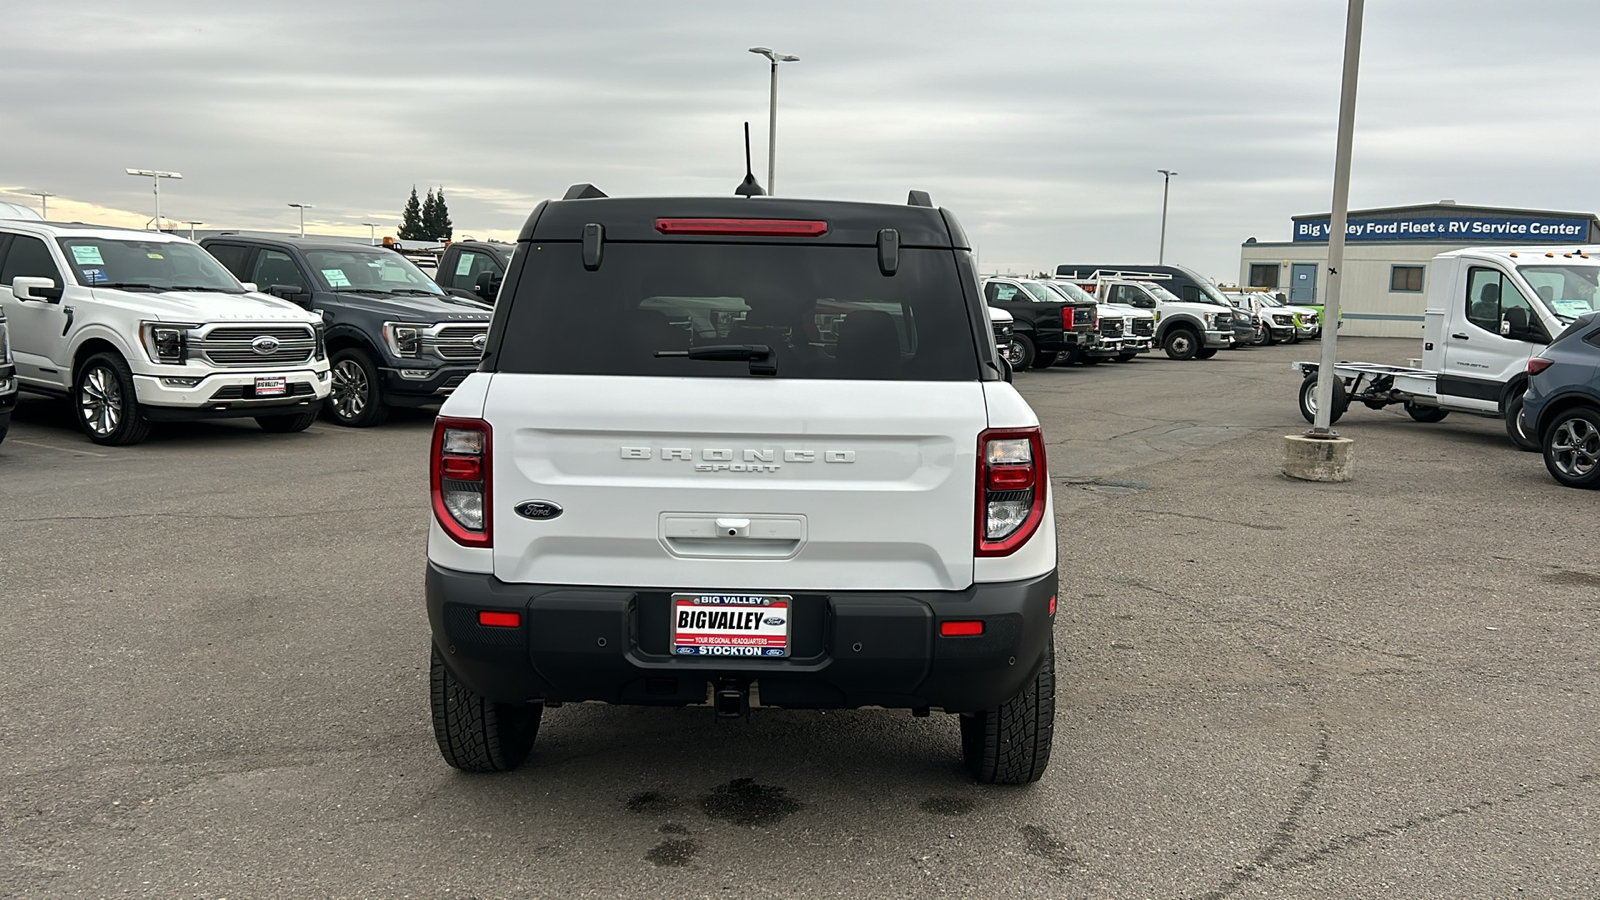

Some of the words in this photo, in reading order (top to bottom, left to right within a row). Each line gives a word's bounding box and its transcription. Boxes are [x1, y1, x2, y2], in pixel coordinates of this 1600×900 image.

[1299, 223, 1320, 236] Big
[1323, 222, 1364, 236] Vley
[1366, 222, 1397, 234] Ford
[1400, 221, 1435, 233] Fleet
[1438, 224, 1445, 233] &
[1449, 221, 1470, 233] RV
[1472, 221, 1526, 234] Service
[1529, 222, 1581, 235] Center
[620, 446, 856, 463] BRONCO
[694, 463, 780, 473] SPORT
[524, 503, 551, 516] Ford
[701, 596, 720, 604] BIG
[723, 596, 763, 605] VALLEY
[765, 617, 783, 625] Ford
[731, 637, 768, 645] HEADQUARTERS
[699, 646, 762, 656] STOCKTON
